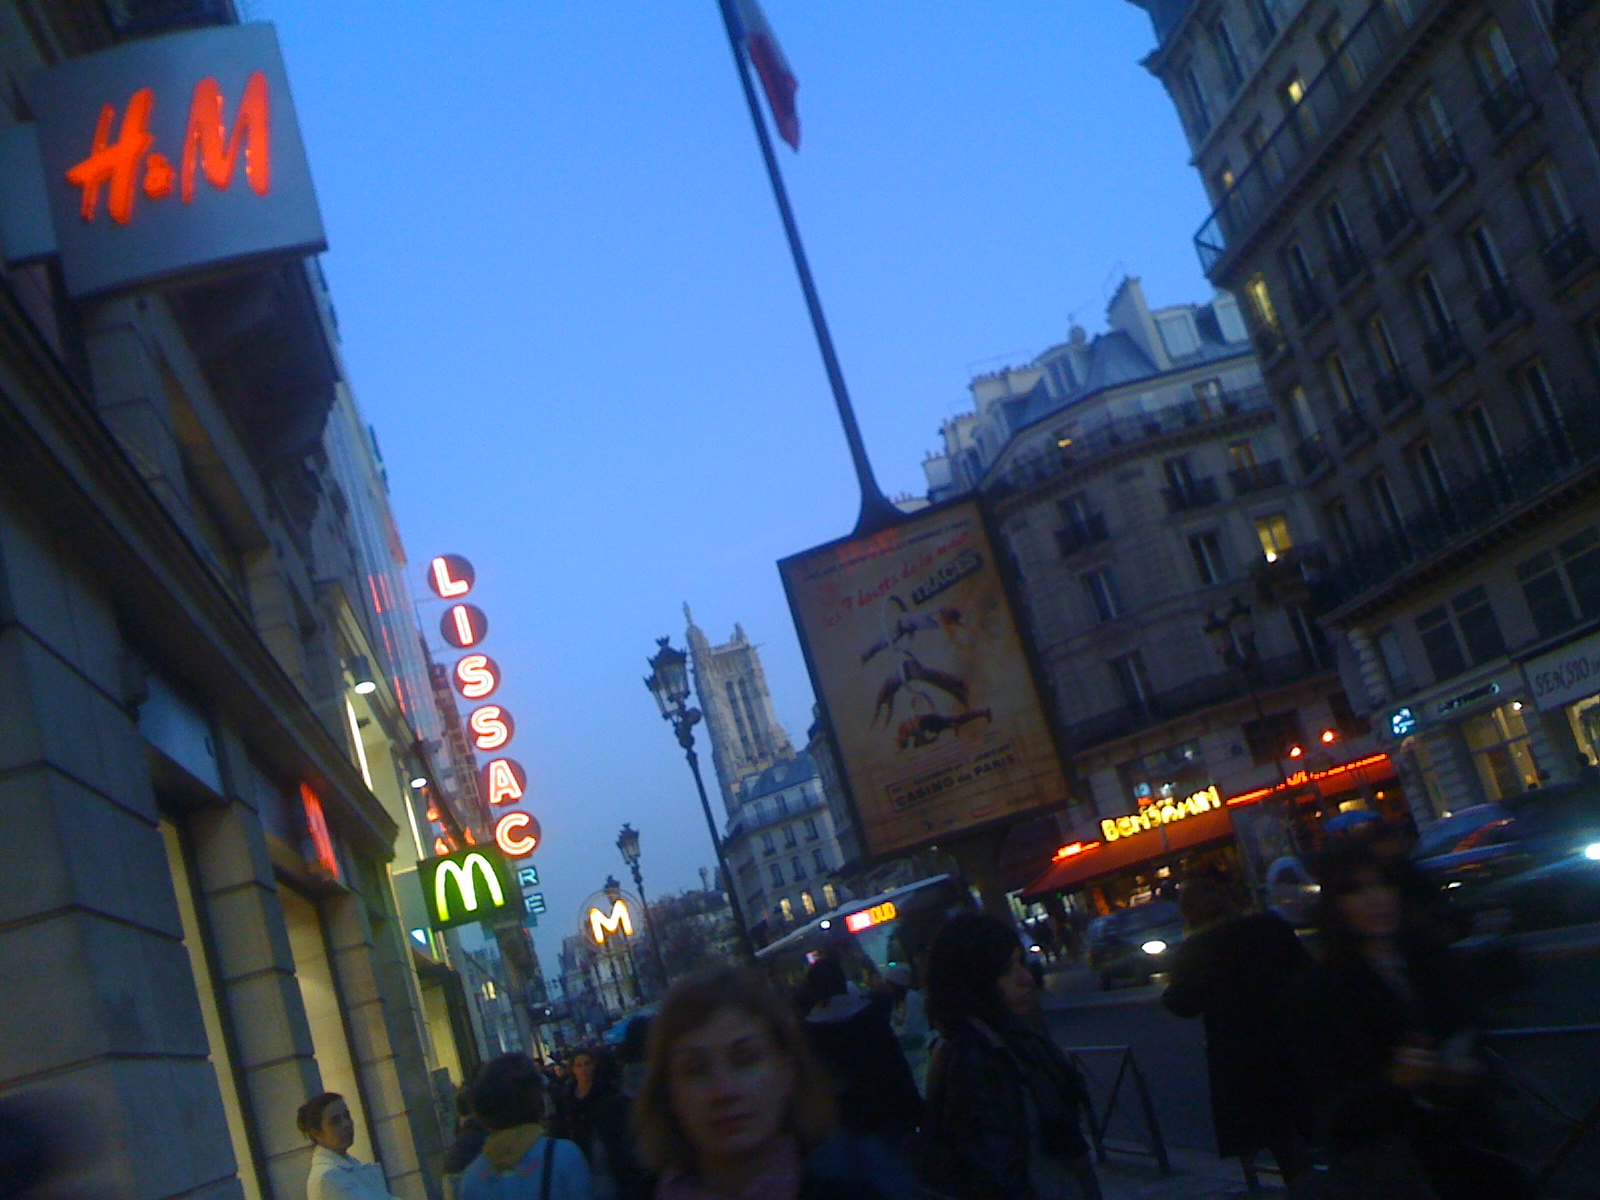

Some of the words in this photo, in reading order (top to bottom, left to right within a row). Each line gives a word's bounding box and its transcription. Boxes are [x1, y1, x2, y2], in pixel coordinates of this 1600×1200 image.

[65, 70, 271, 225] H&M
[430, 555, 537, 857] LISSAC
[588, 899, 634, 944] M
